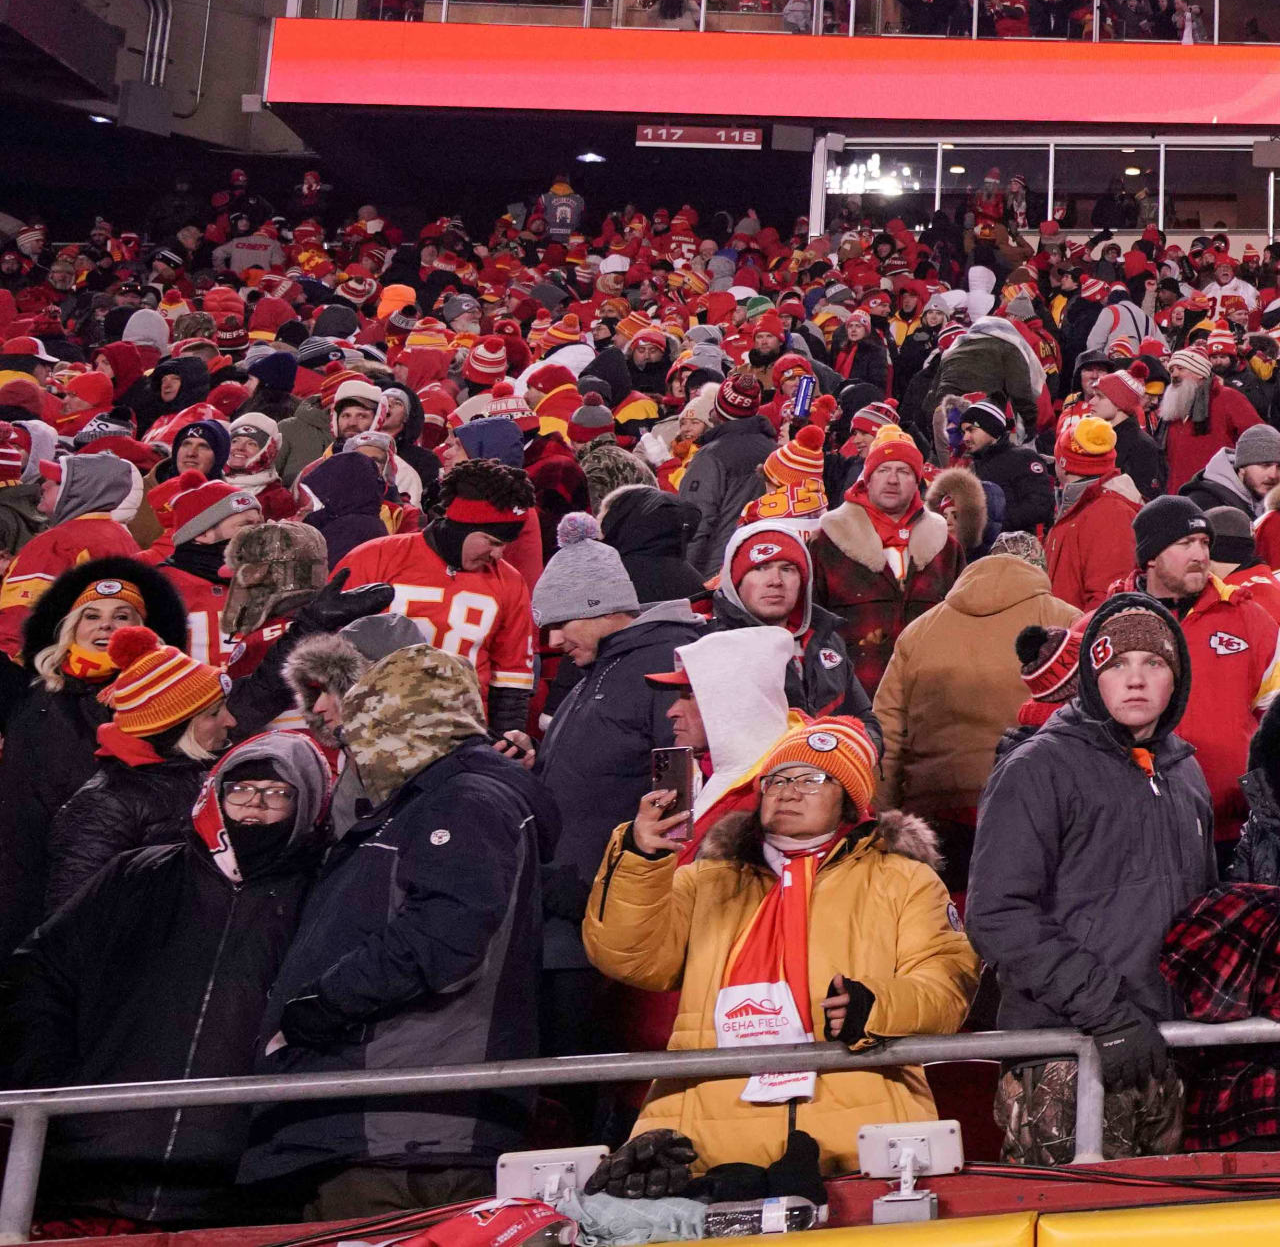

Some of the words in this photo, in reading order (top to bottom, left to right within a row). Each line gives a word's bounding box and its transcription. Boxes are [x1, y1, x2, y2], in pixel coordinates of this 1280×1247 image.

[643, 128, 684, 140] 117
[716, 130, 756, 142] 118
[216, 329, 246, 341] HIEFS
[389, 583, 498, 679] 58
[722, 1020, 755, 1032] GEHA
[758, 1017, 790, 1028] FIELD
